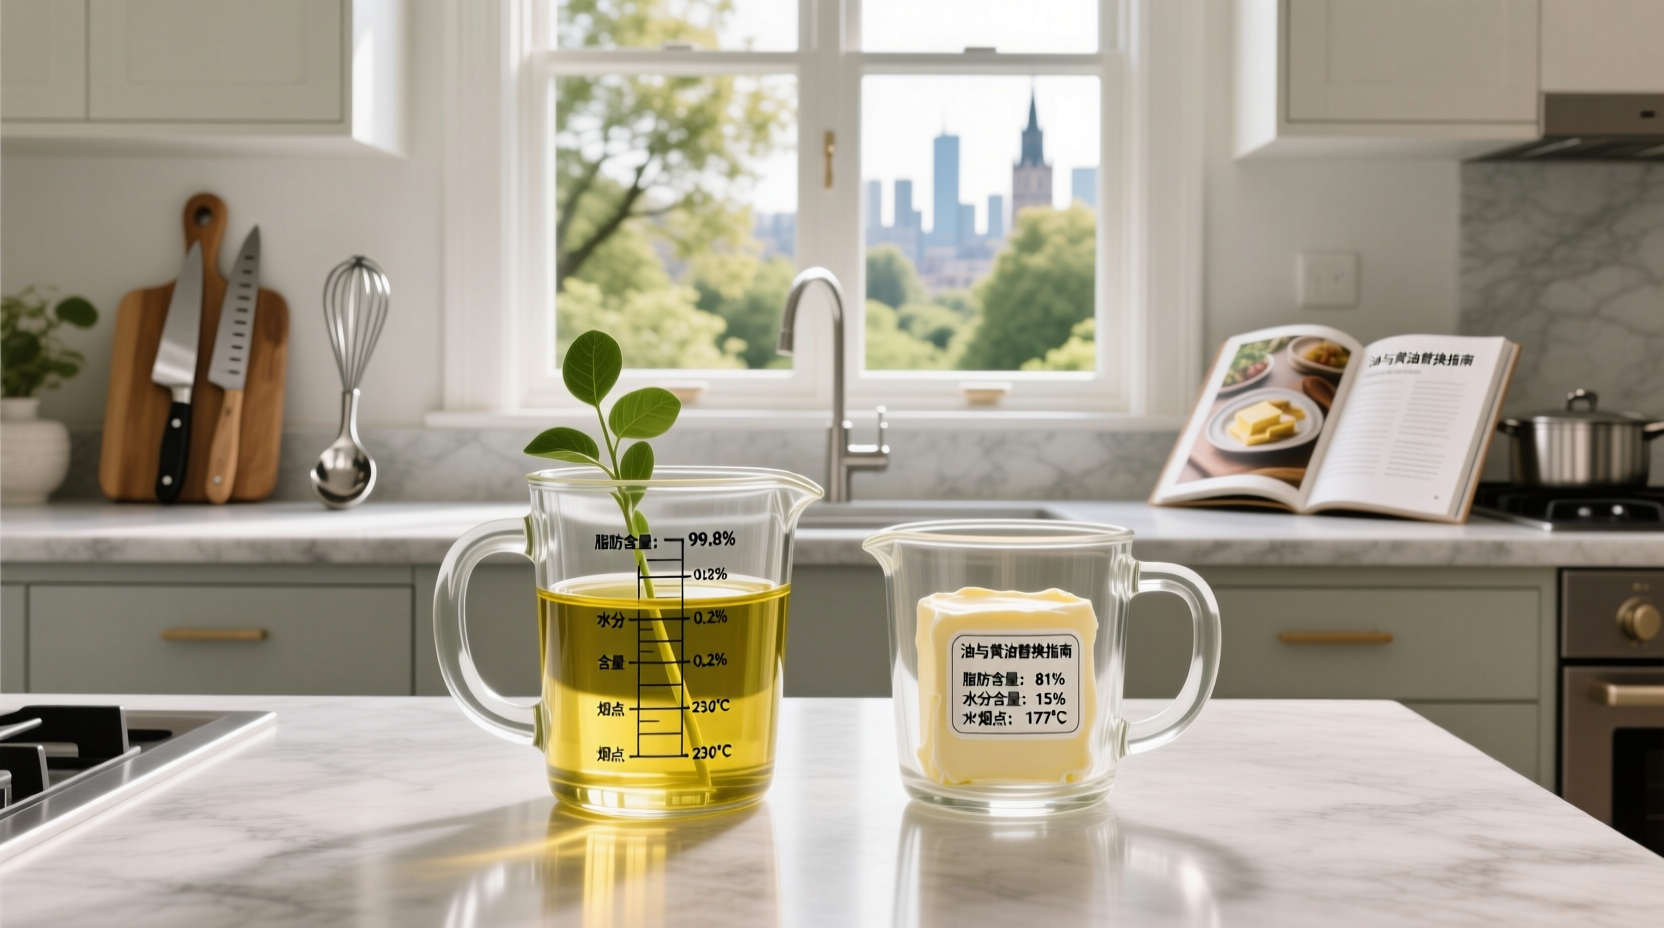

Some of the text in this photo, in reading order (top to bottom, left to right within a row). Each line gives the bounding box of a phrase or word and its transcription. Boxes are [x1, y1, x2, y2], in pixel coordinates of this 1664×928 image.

[688, 530, 736, 547] 99.8%
[596, 609, 728, 628] 水分 0.2%
[597, 652, 728, 670] 含量 0.2%
[1035, 671, 1066, 686] 81%
[1035, 691, 1066, 706] 15%
[1025, 709, 1068, 725] 177°C
